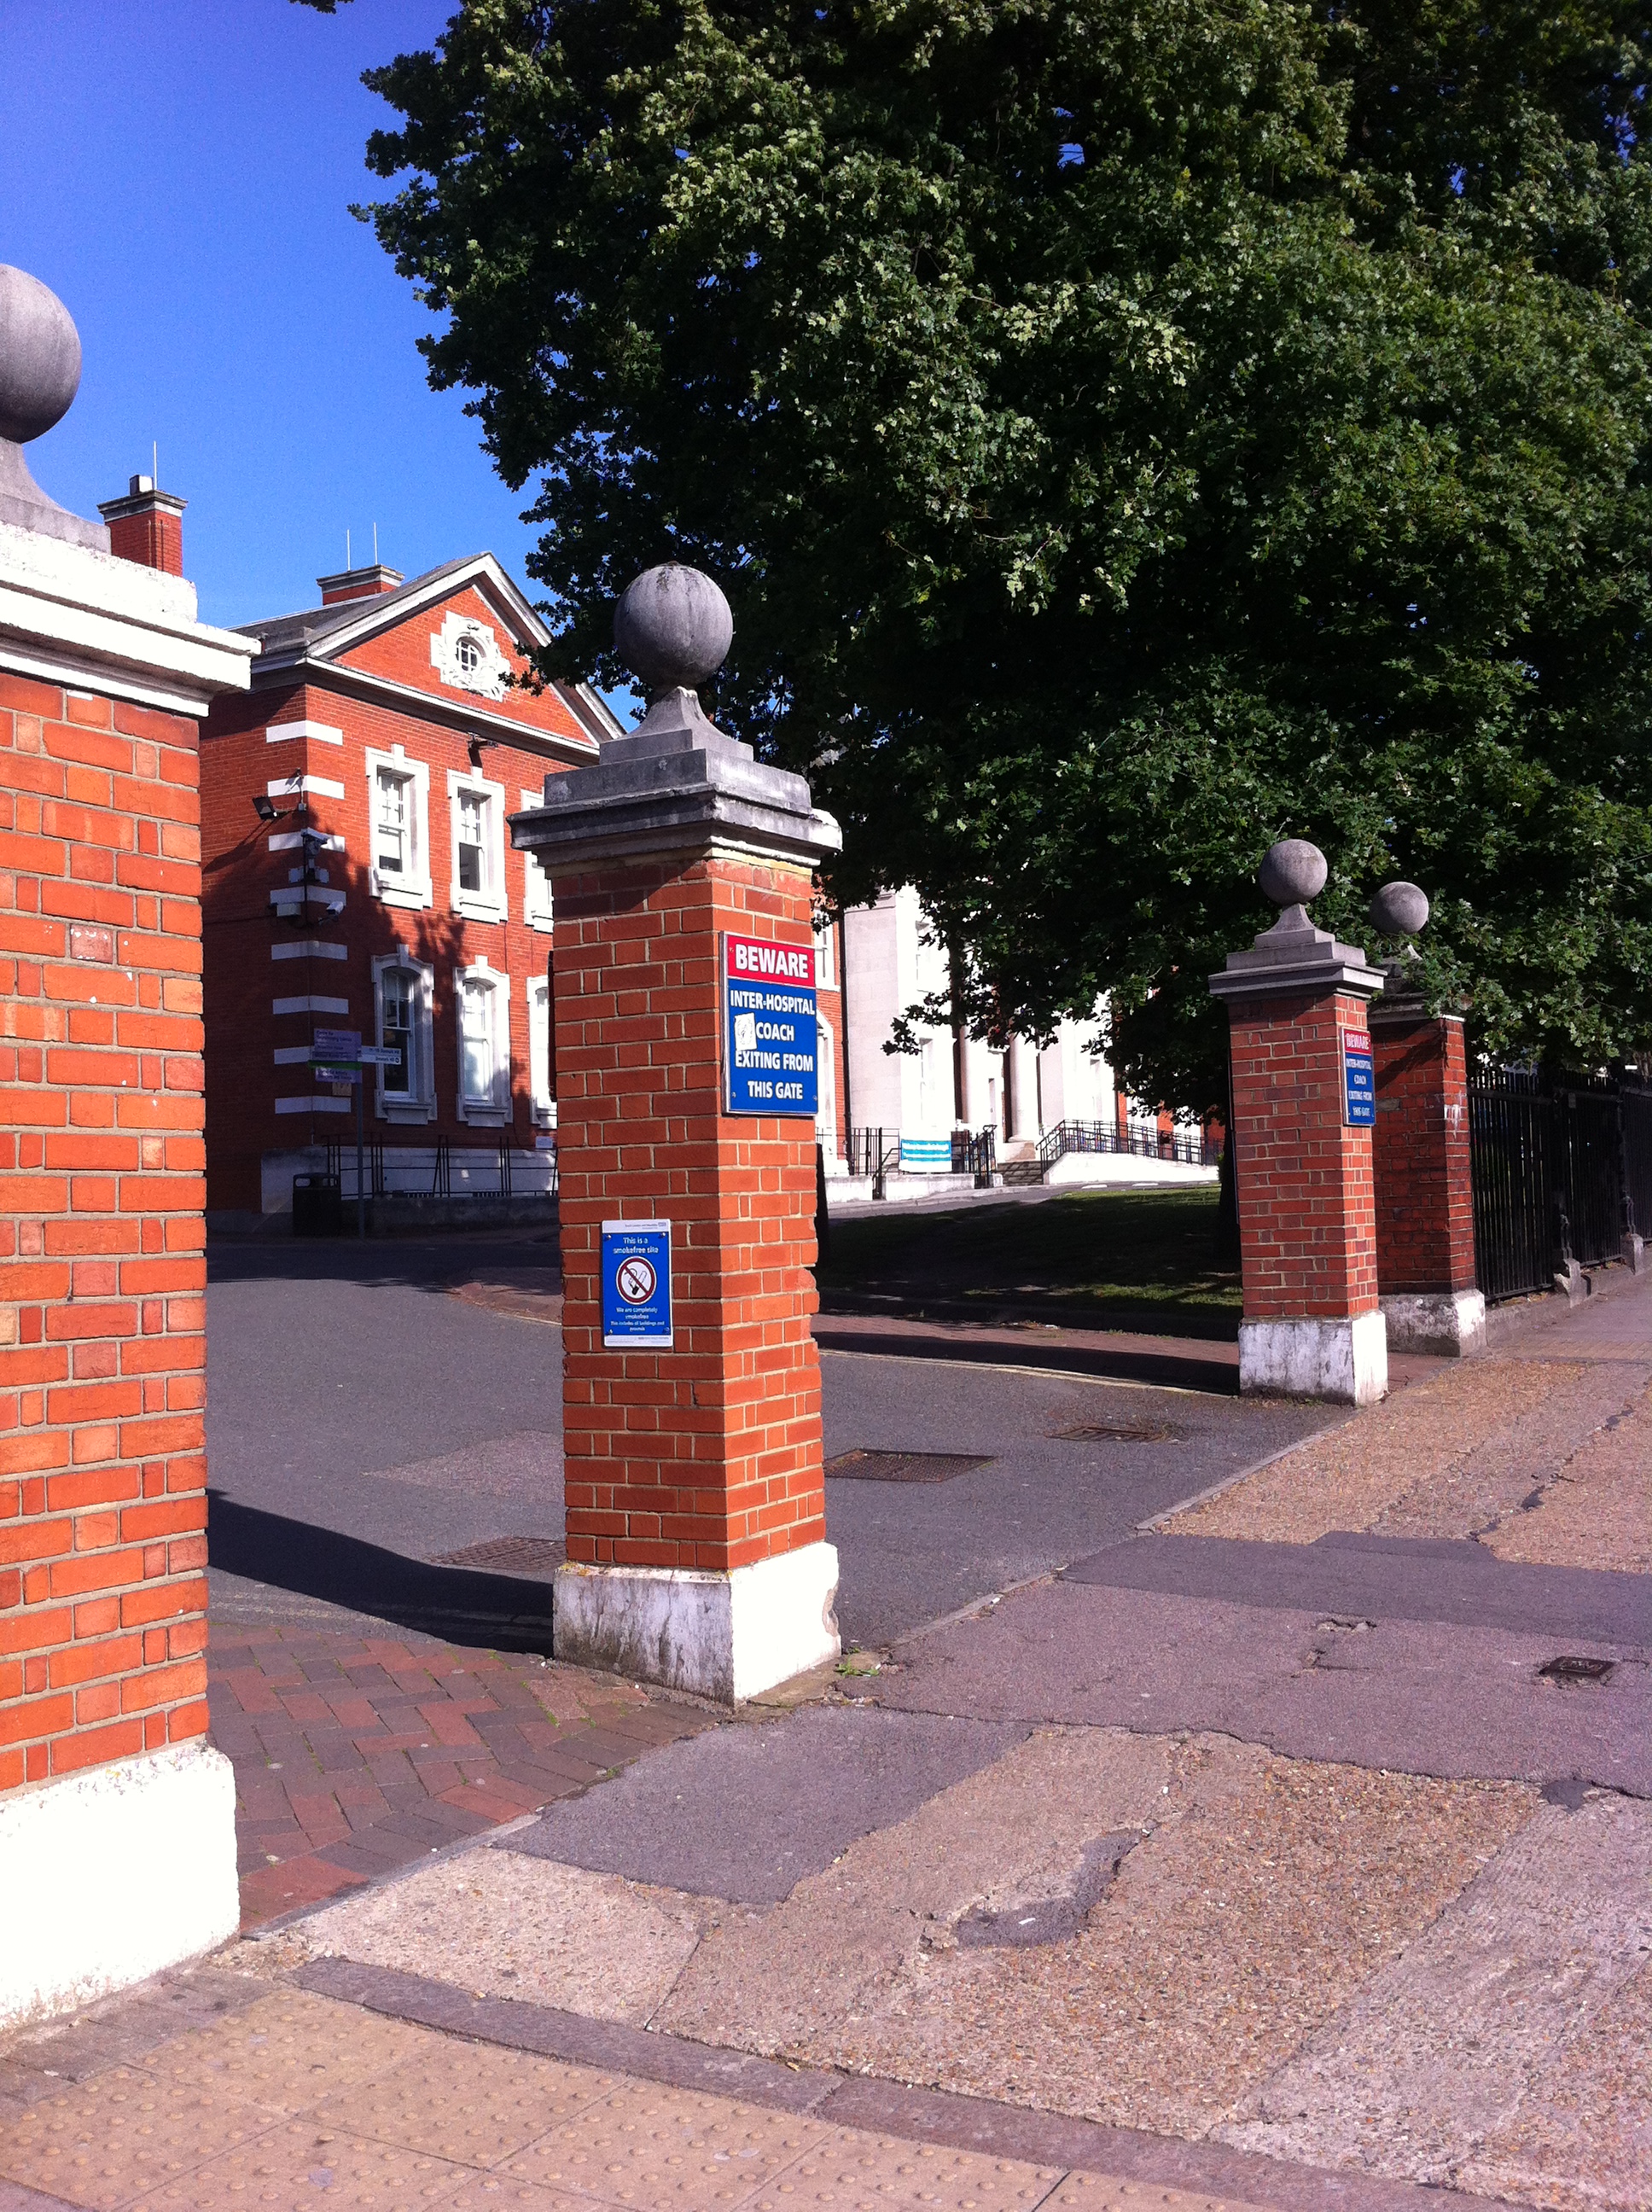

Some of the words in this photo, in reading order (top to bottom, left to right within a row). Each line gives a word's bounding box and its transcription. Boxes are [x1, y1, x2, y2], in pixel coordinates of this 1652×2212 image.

[735, 943, 809, 979] BEWARE
[730, 989, 816, 1016] INTER-HOSPITAL
[755, 1022, 795, 1042] COACH
[1346, 1033, 1370, 1050] BEWARE
[735, 1051, 781, 1070] EXITING
[782, 1053, 814, 1073] FROM
[747, 1080, 773, 1099] THIS
[775, 1081, 804, 1100] GATE
